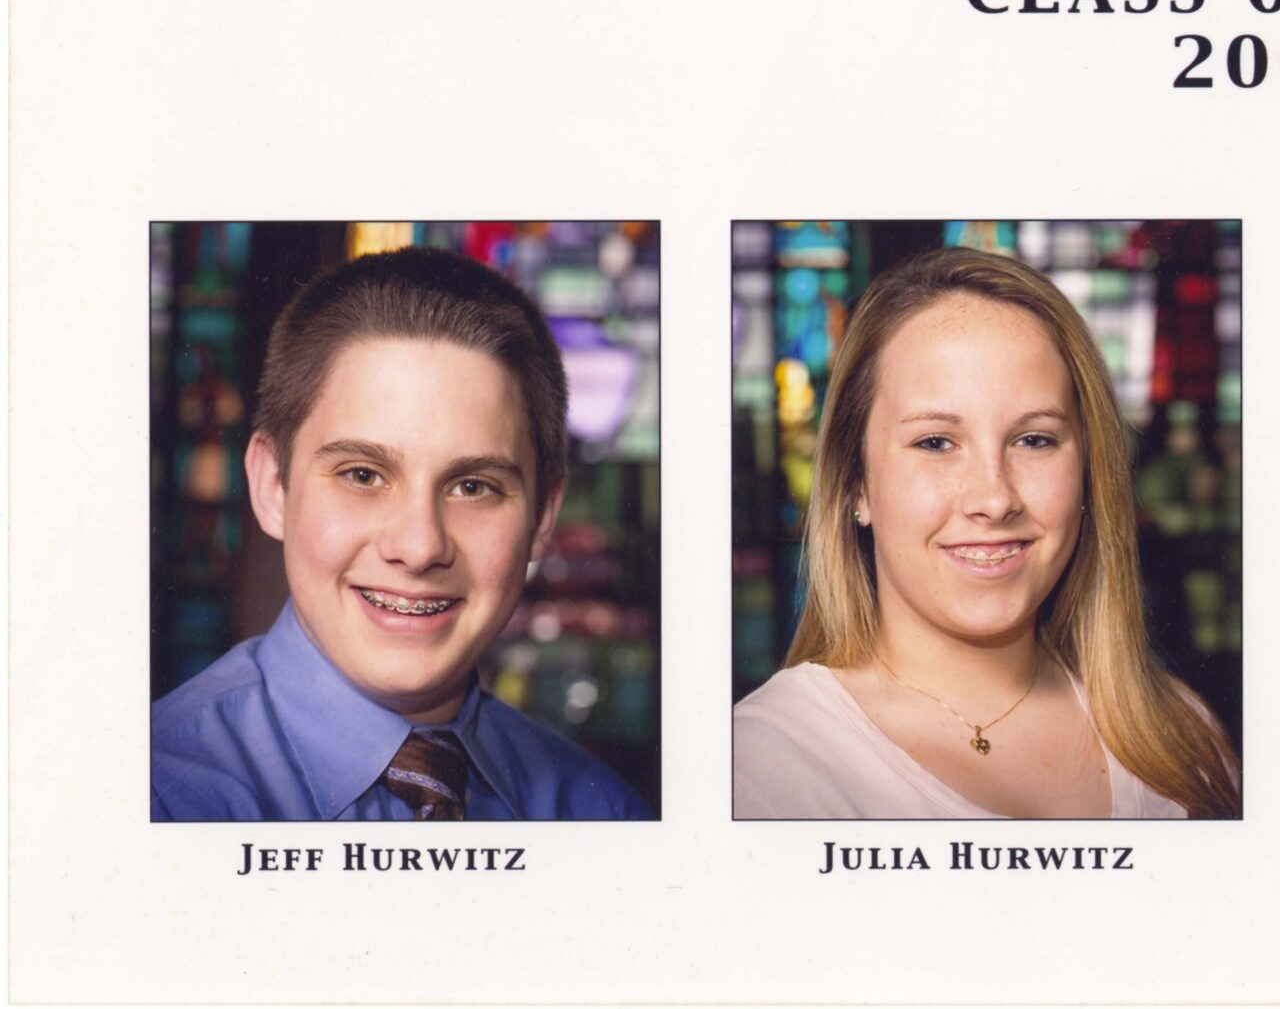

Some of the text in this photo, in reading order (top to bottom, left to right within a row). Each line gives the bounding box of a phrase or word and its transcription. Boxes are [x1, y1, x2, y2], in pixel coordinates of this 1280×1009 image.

[237, 843, 526, 876] JEFF HURWITZ
[819, 841, 1134, 874] JULIA HURWITZ
